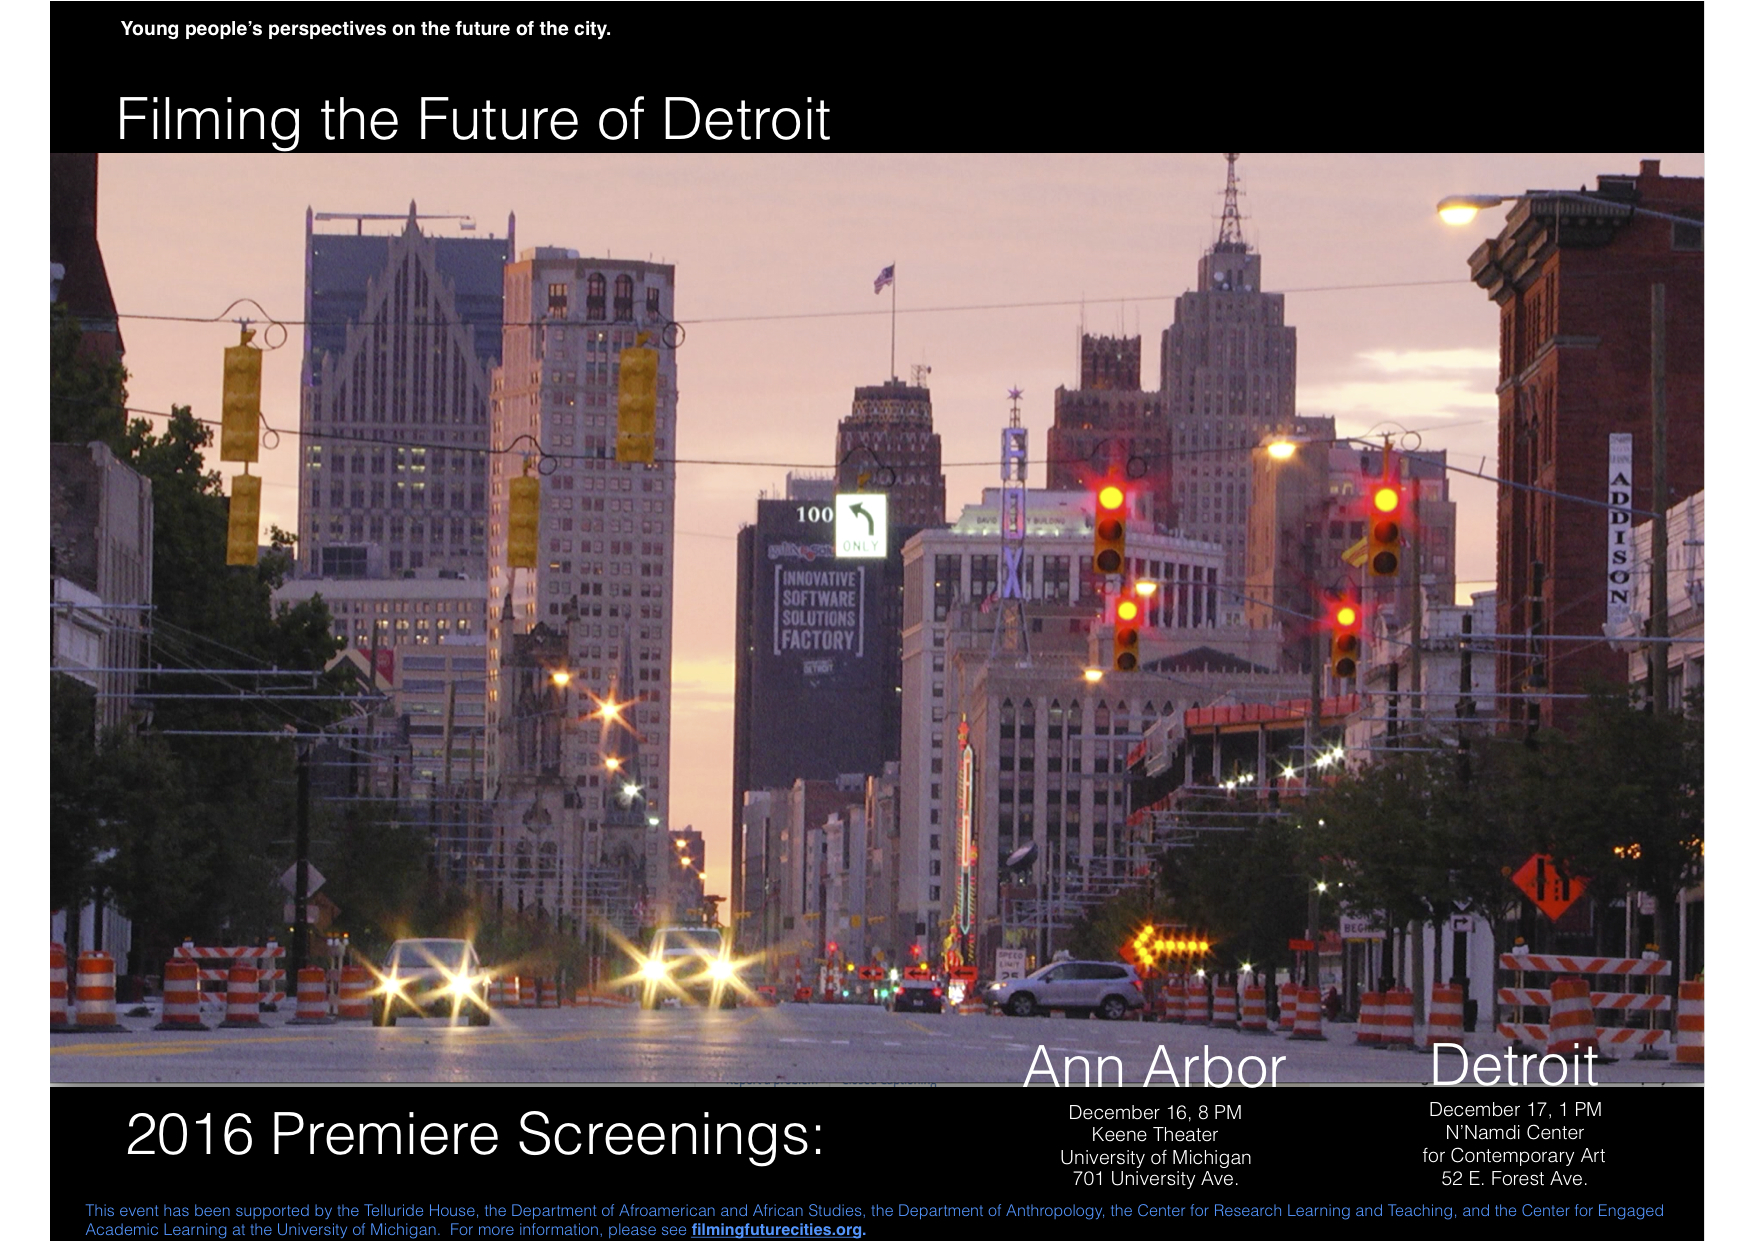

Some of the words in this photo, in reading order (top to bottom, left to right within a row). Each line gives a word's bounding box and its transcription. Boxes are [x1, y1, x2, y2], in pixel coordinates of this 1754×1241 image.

[796, 505, 834, 523] 100
[1004, 428, 1025, 599] FOX
[843, 540, 879, 552] ONLY
[1610, 472, 1631, 604] ADDISON
[783, 571, 856, 587] INNOVATIVE
[783, 590, 856, 607] SOFTWARE
[782, 609, 855, 627] SOLUTIONS
[782, 629, 855, 650] FACTORY
[998, 951, 1024, 960] SPEED
[999, 961, 1020, 969] LIMIT
